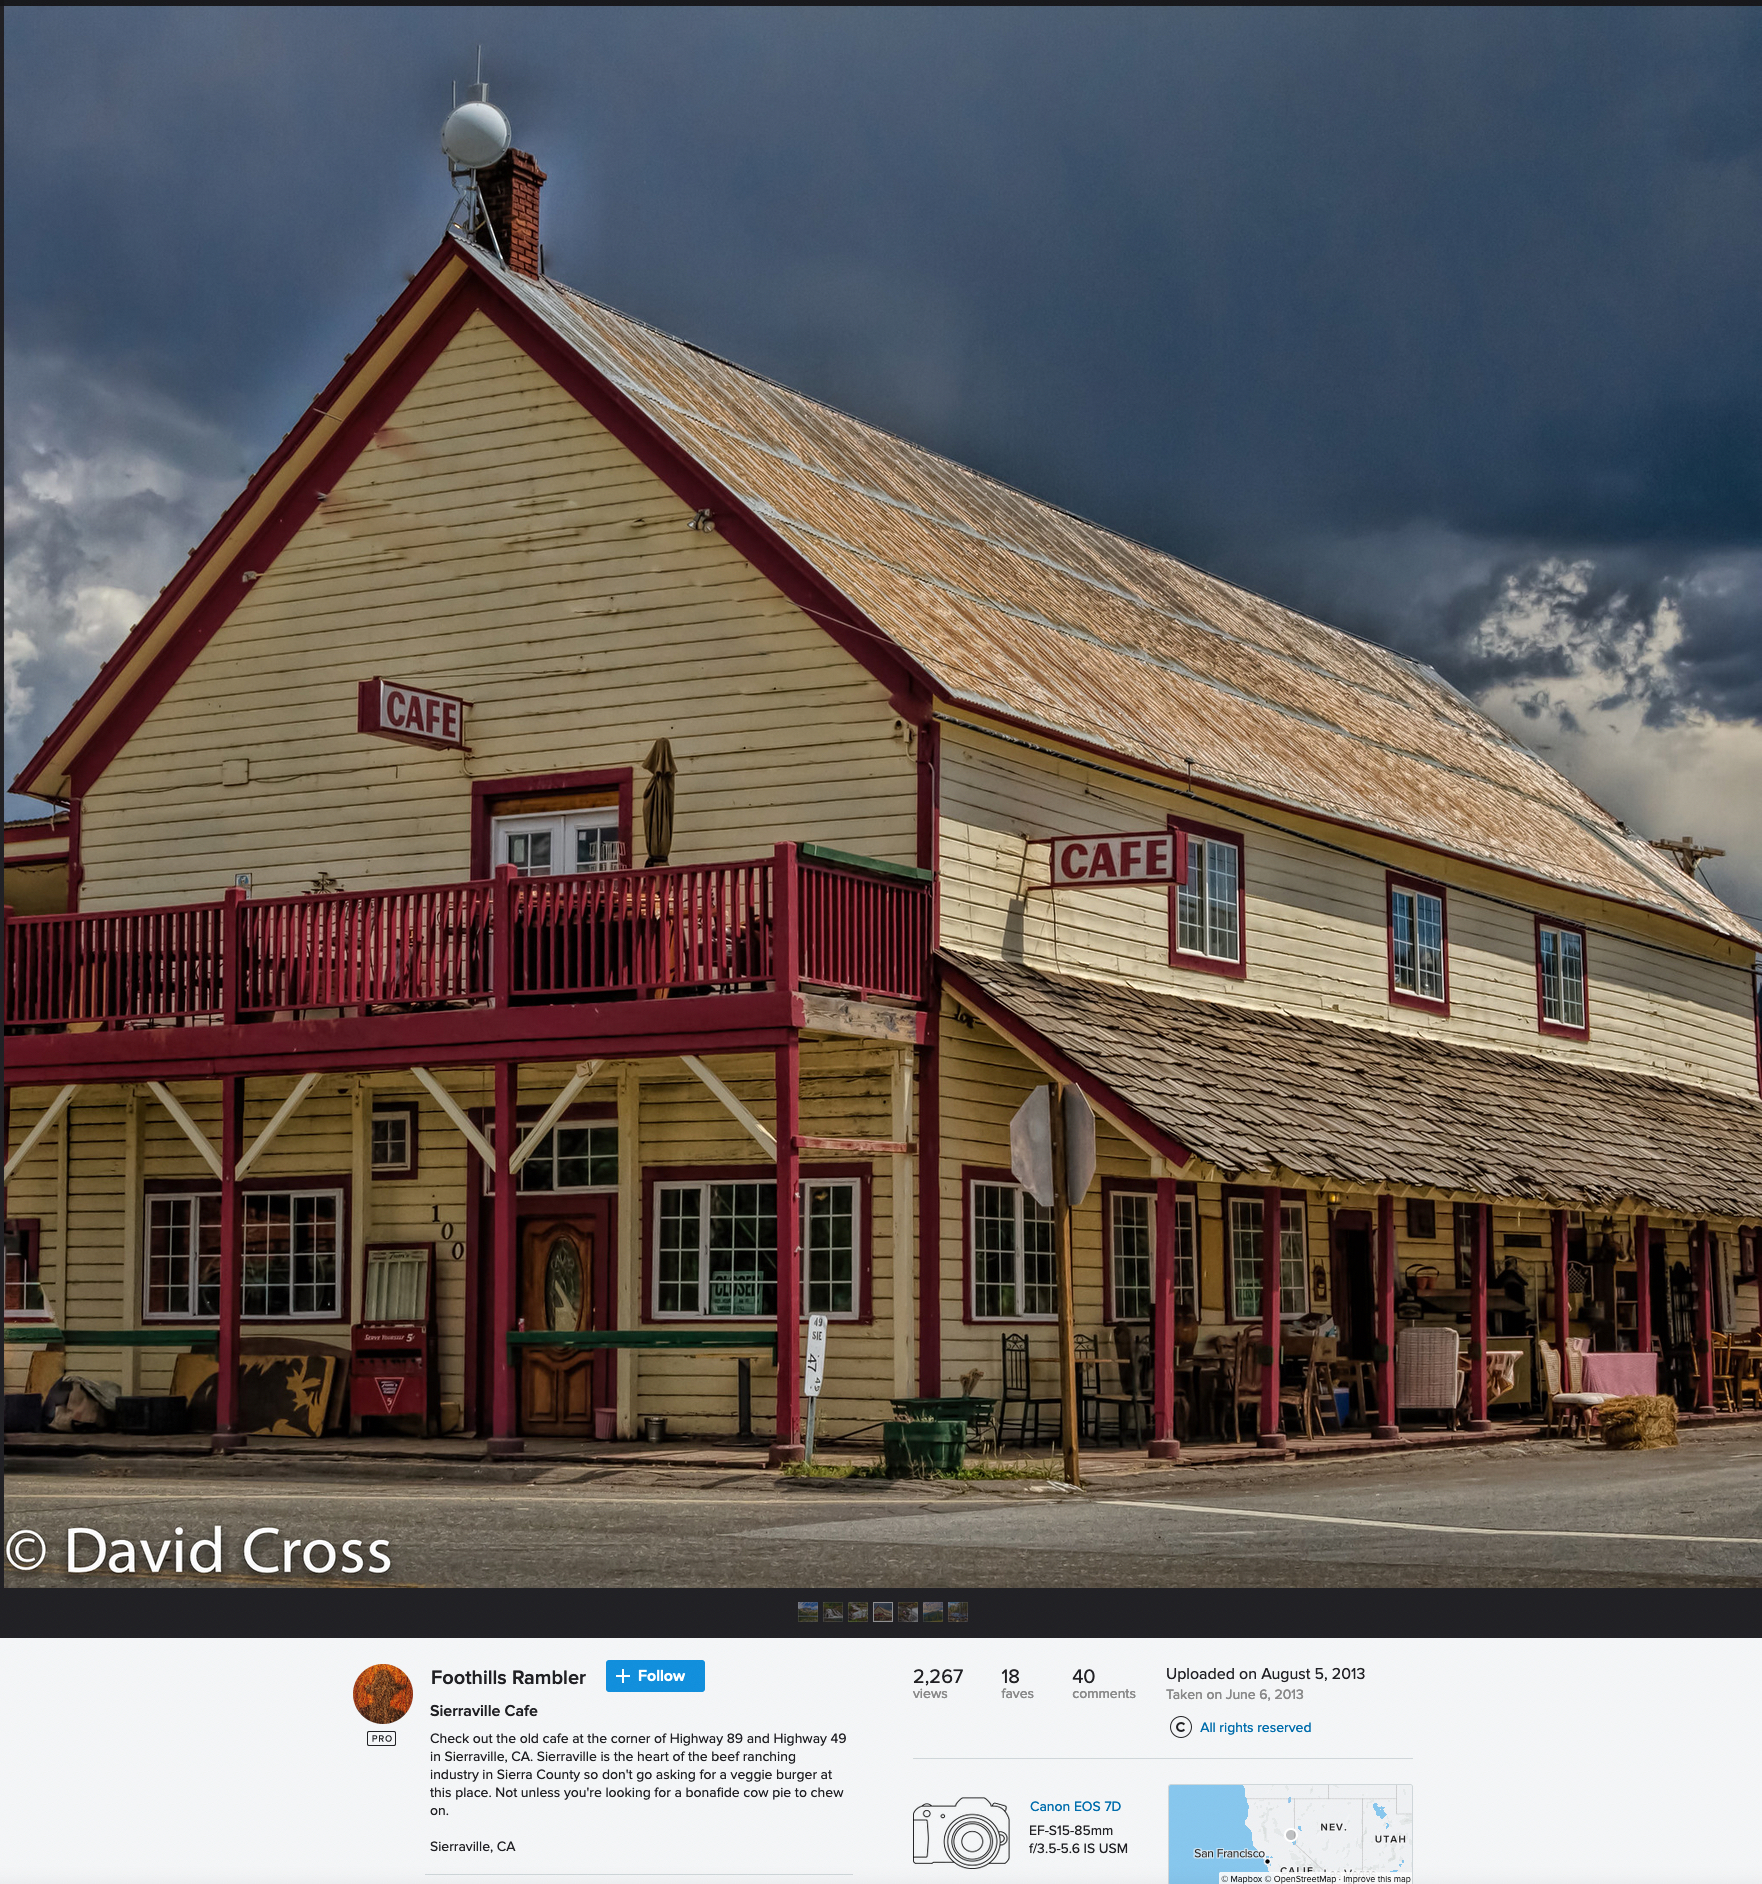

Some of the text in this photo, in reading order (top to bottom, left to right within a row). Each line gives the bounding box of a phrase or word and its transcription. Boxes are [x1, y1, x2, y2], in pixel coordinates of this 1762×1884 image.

[387, 691, 456, 738] CAFE
[1061, 840, 1167, 879] CAFE
[715, 1275, 760, 1297] CLOSED
[813, 1317, 823, 1327] 49
[811, 1331, 822, 1341] SIE
[807, 1354, 817, 1373] 47
